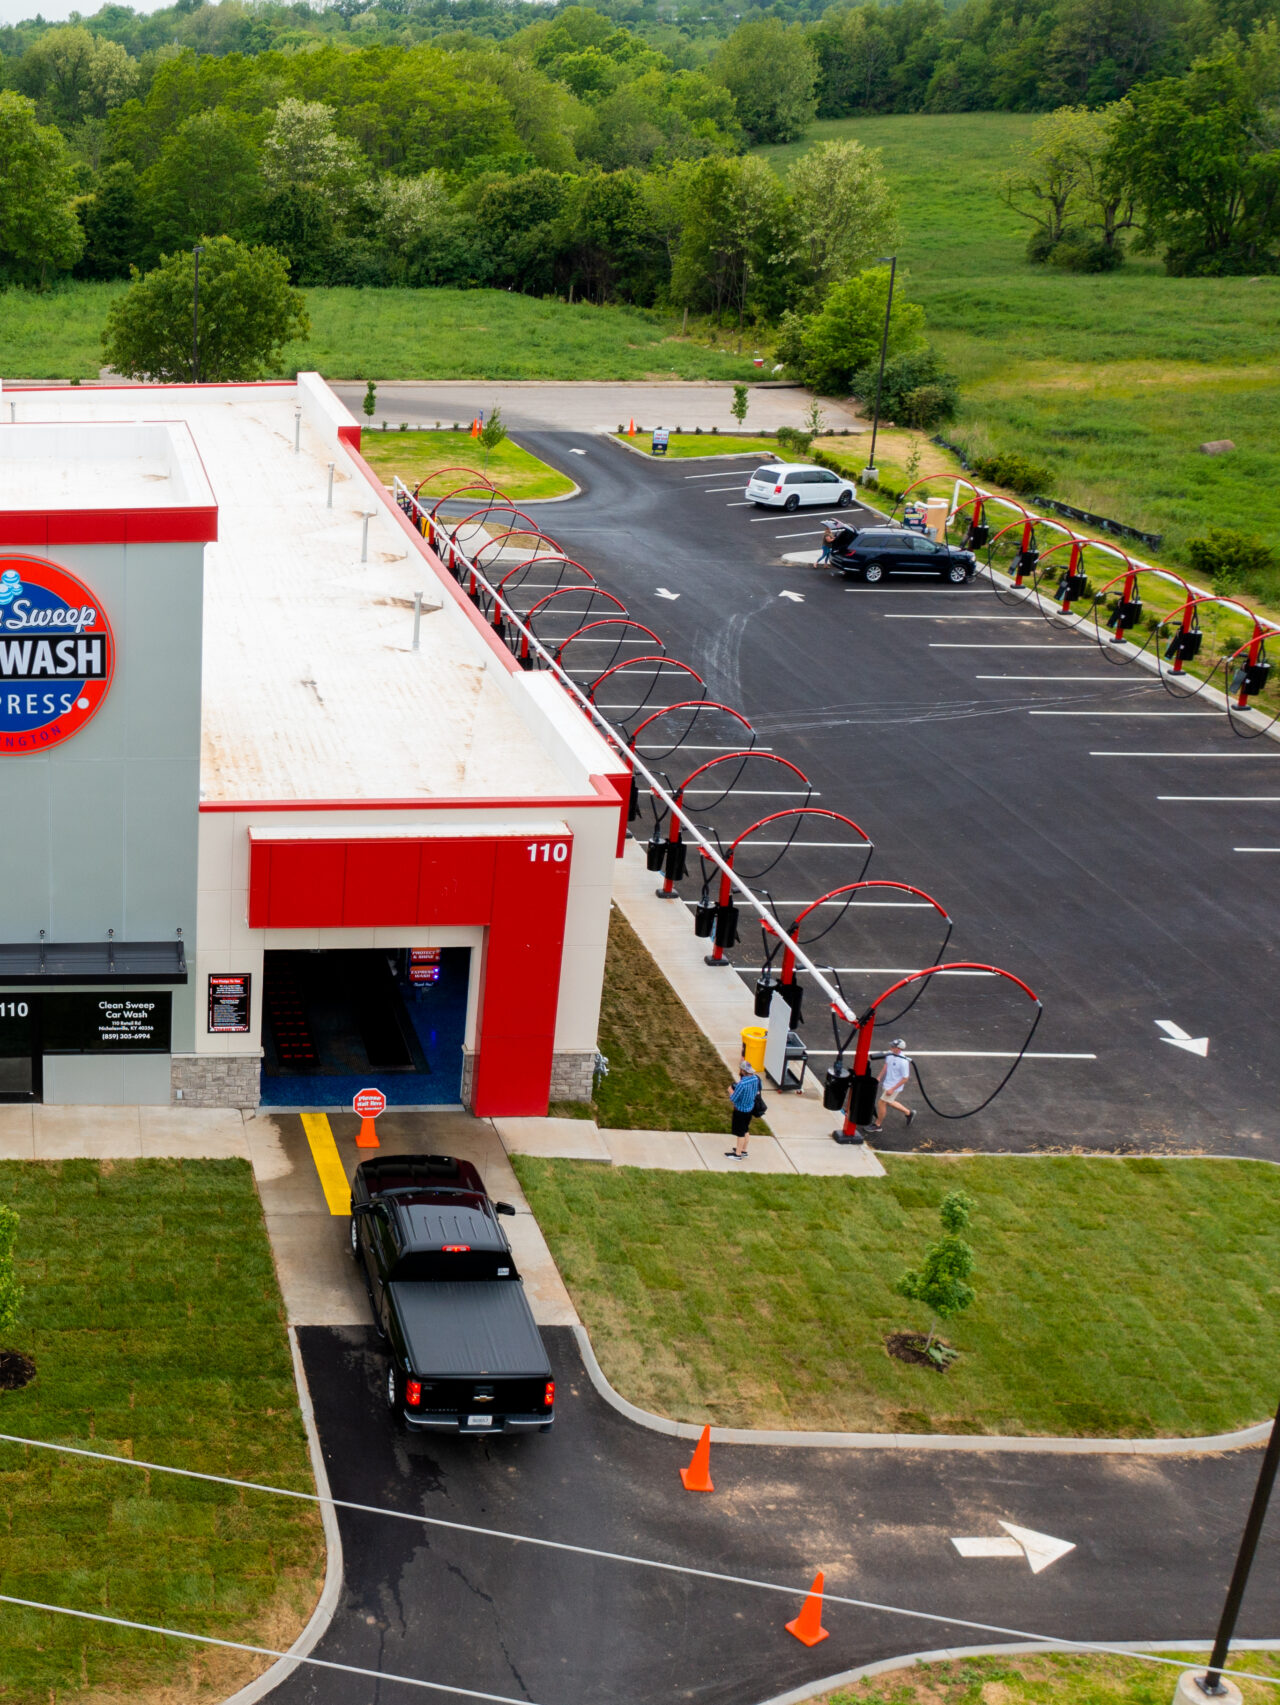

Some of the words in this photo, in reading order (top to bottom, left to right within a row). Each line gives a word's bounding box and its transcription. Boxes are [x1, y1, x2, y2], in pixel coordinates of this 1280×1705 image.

[5, 600, 97, 634] Sweep
[527, 843, 568, 862] 110
[98, 1001, 123, 1009] Clean
[125, 1001, 155, 1010] Sweep
[105, 1010, 121, 1018] Car
[123, 1010, 148, 1018] Wash
